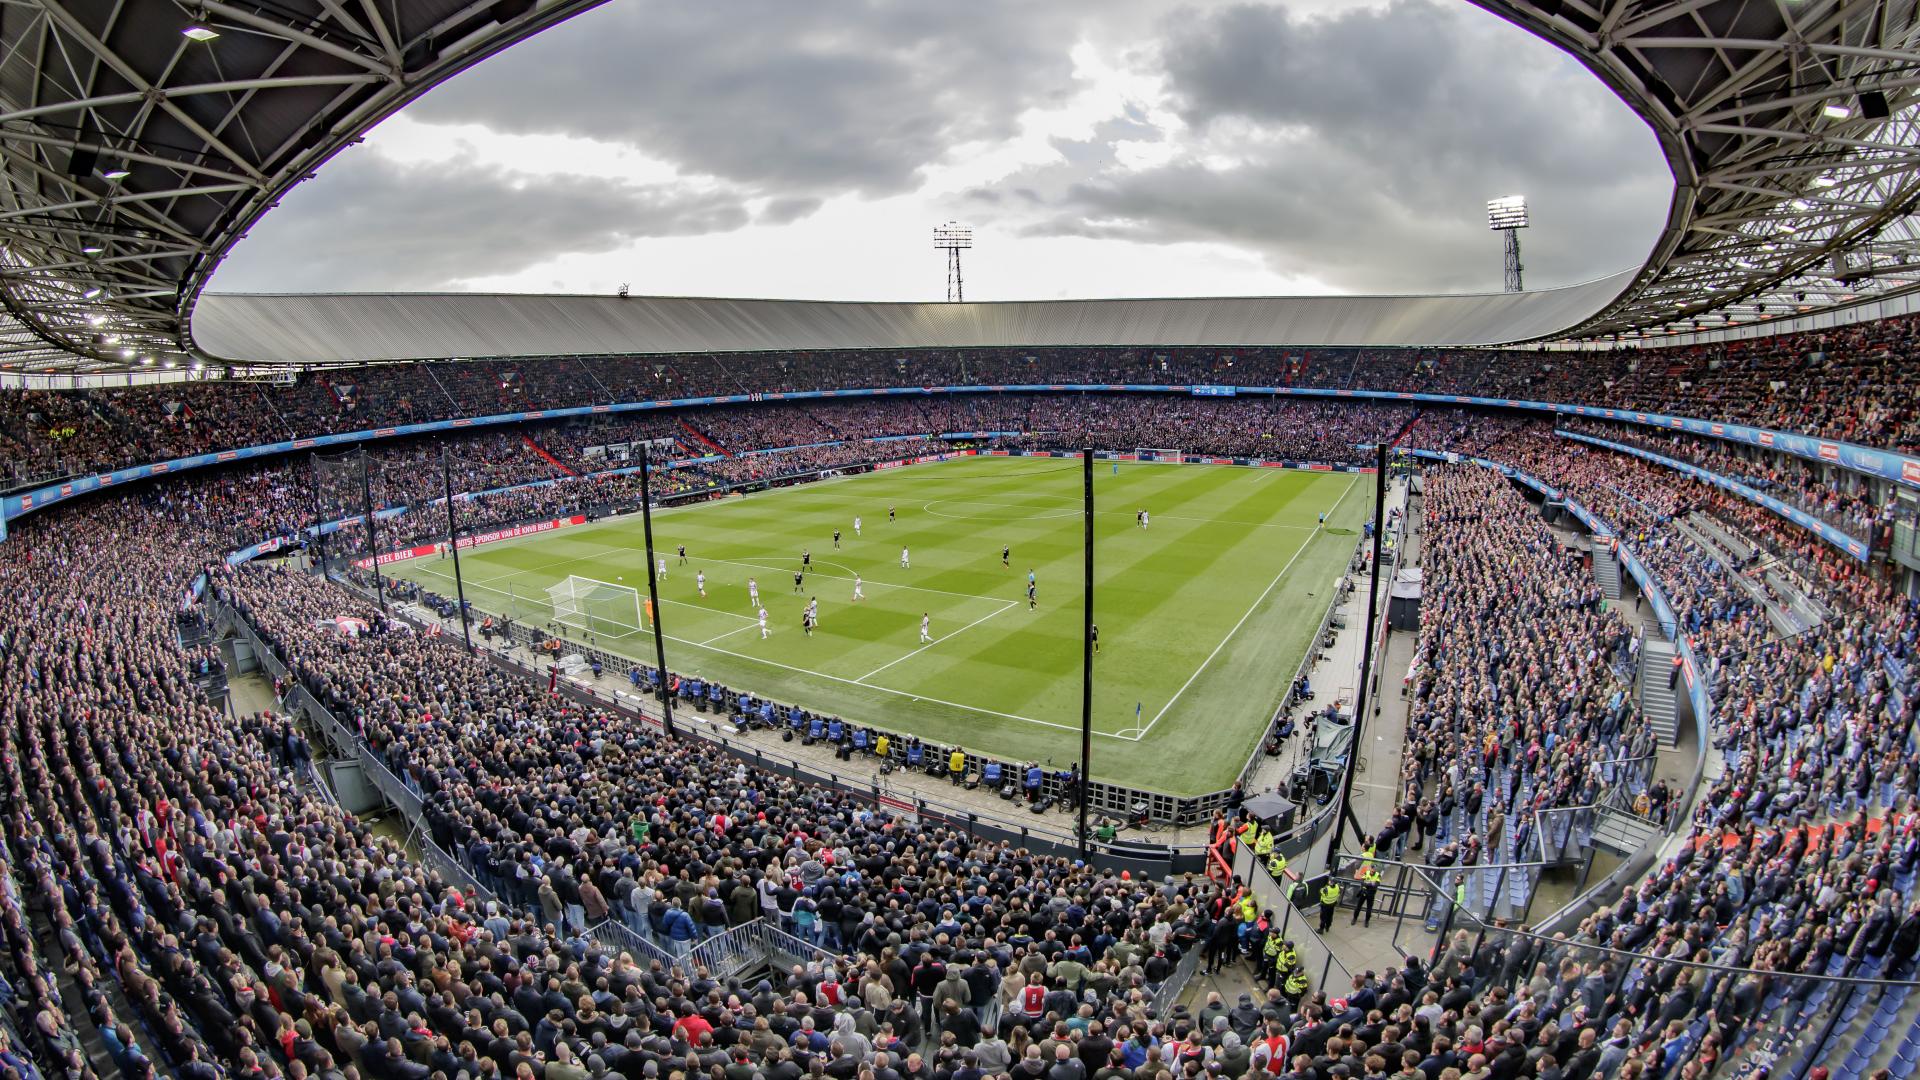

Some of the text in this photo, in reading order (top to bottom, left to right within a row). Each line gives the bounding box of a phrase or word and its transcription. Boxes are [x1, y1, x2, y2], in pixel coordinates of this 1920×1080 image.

[475, 532, 500, 543] SPONSOR
[500, 530, 513, 538] VAN
[514, 528, 521, 536] DE
[522, 524, 537, 535] KNVB
[538, 521, 554, 531] BEKER
[365, 549, 413, 568] AMSTEL BIER
